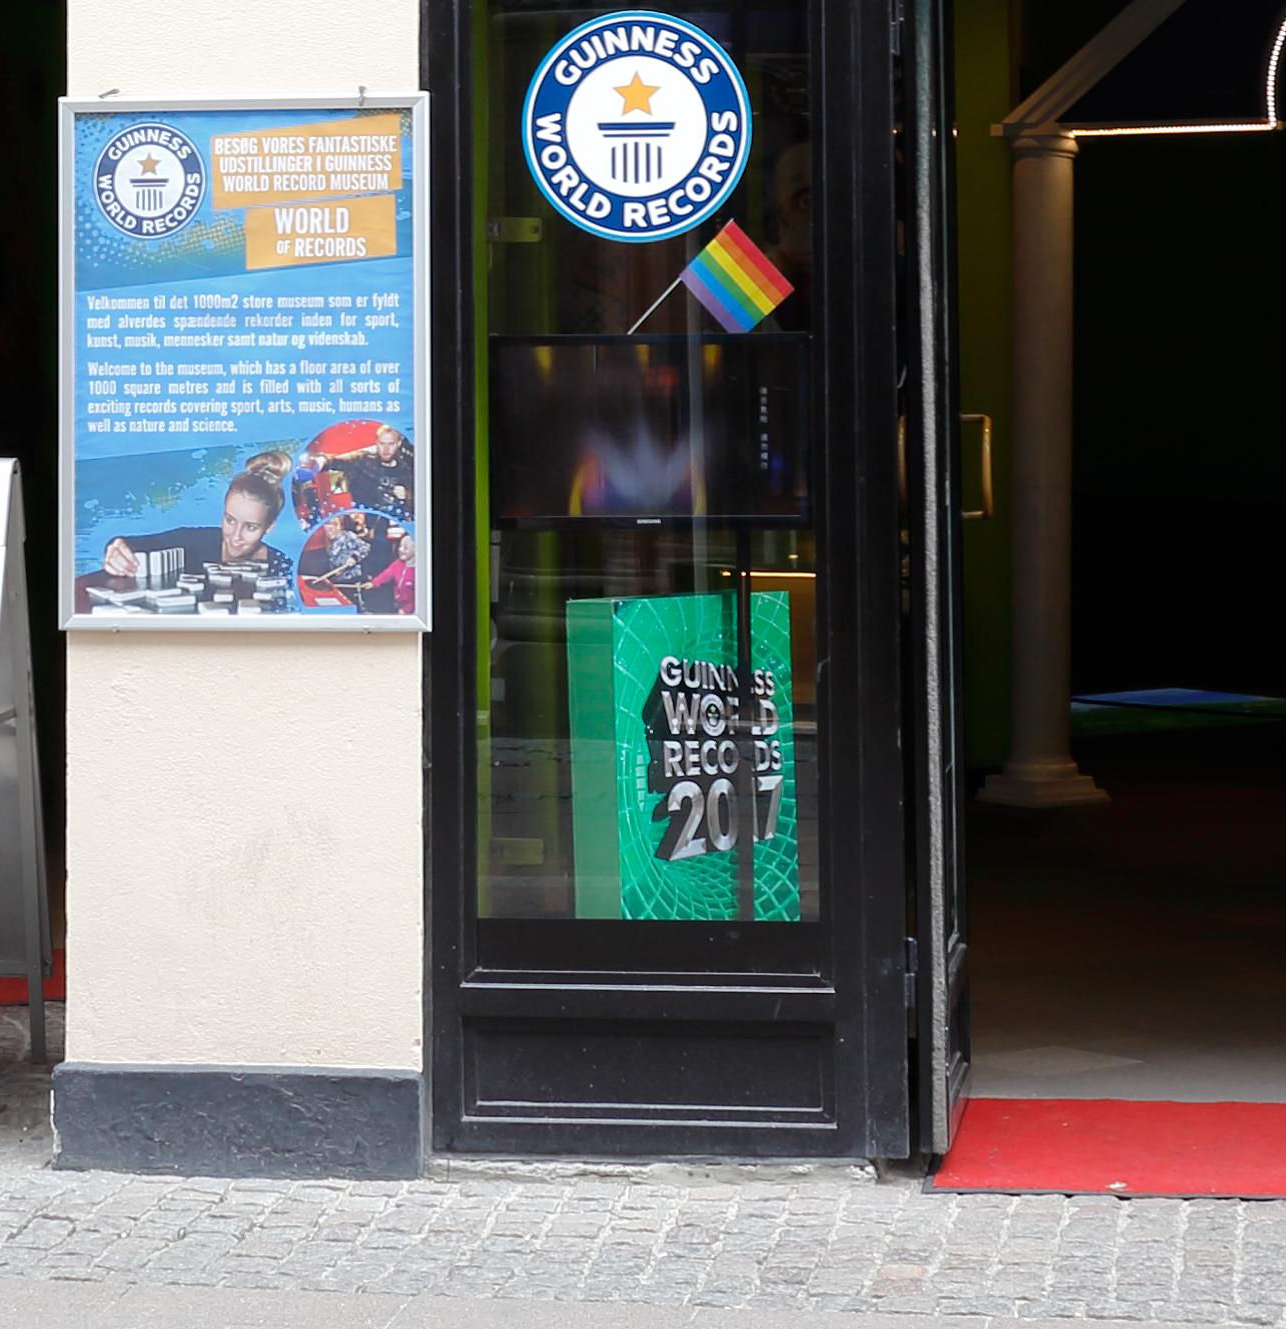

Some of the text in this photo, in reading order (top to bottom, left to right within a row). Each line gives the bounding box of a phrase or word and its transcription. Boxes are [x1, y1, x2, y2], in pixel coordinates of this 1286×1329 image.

[553, 25, 719, 85] GUINNESS
[108, 128, 192, 160] GUINNESS
[214, 135, 397, 155] BESØG VORES FANTASTISKE
[219, 155, 392, 173] UDSTILLINGER I GUINNESS
[535, 110, 738, 228] WORLD RECORDS
[223, 174, 388, 191] WORLD RECORD MUSEUM
[98, 172, 201, 233] WORLD RECORDS
[274, 207, 348, 233] WORLD
[276, 238, 366, 257] OF RECORDS
[87, 292, 399, 310] Velkommen til det 1000m2 store museum som er fyldt
[87, 312, 398, 330] med alverdes spændende rekorder inden for sport,
[87, 331, 367, 349] kunst, musik, mennesker samt natur og videnskab.
[87, 359, 398, 375] Welcome to the museum, which has a floor area of over
[89, 378, 399, 397] 1000 square metres and is filled with all sorts of
[87, 398, 399, 416] exciting records covering sport, arts, music, humans as
[87, 418, 236, 432] well as nature and science.
[660, 656, 775, 696] GUINNSS
[663, 740, 782, 777] RECODS
